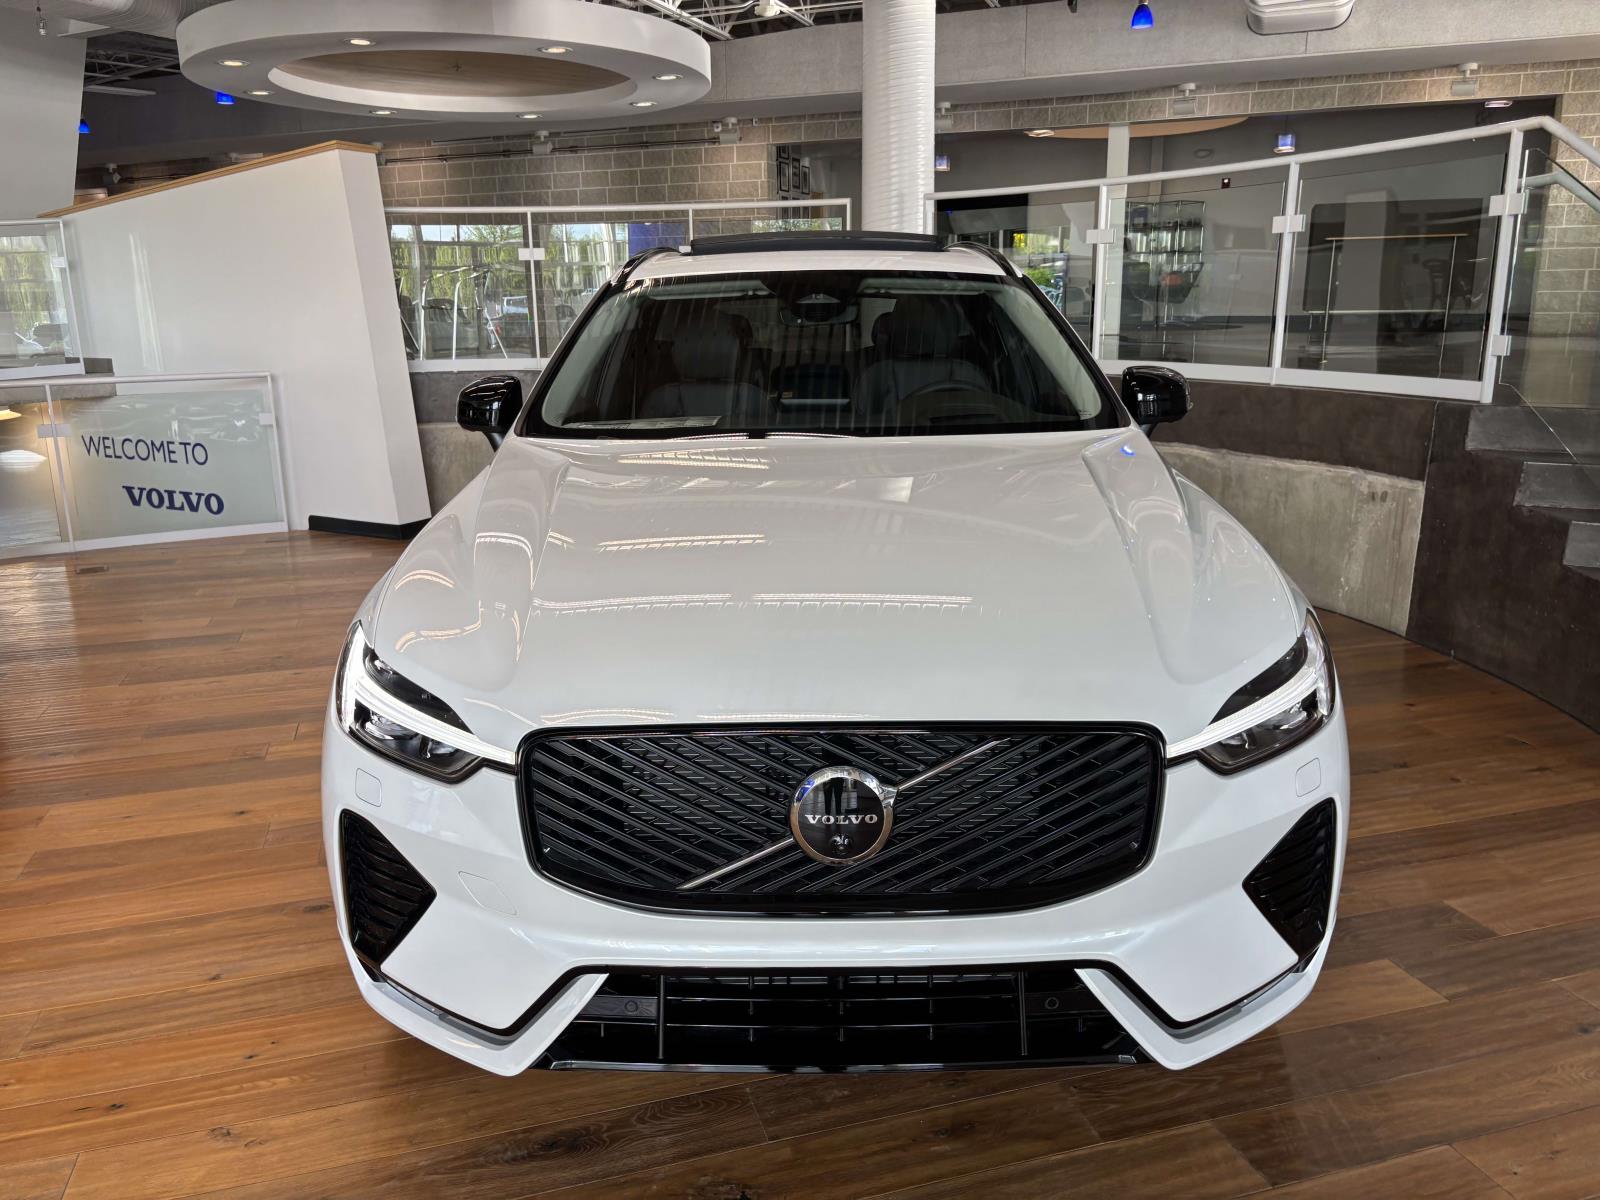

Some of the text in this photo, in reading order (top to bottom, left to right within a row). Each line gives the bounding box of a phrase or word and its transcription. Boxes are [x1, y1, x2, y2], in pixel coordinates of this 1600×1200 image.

[81, 434, 209, 466] WELCOME TO
[122, 485, 224, 515] VOLVO
[804, 814, 878, 824] VOLVO
